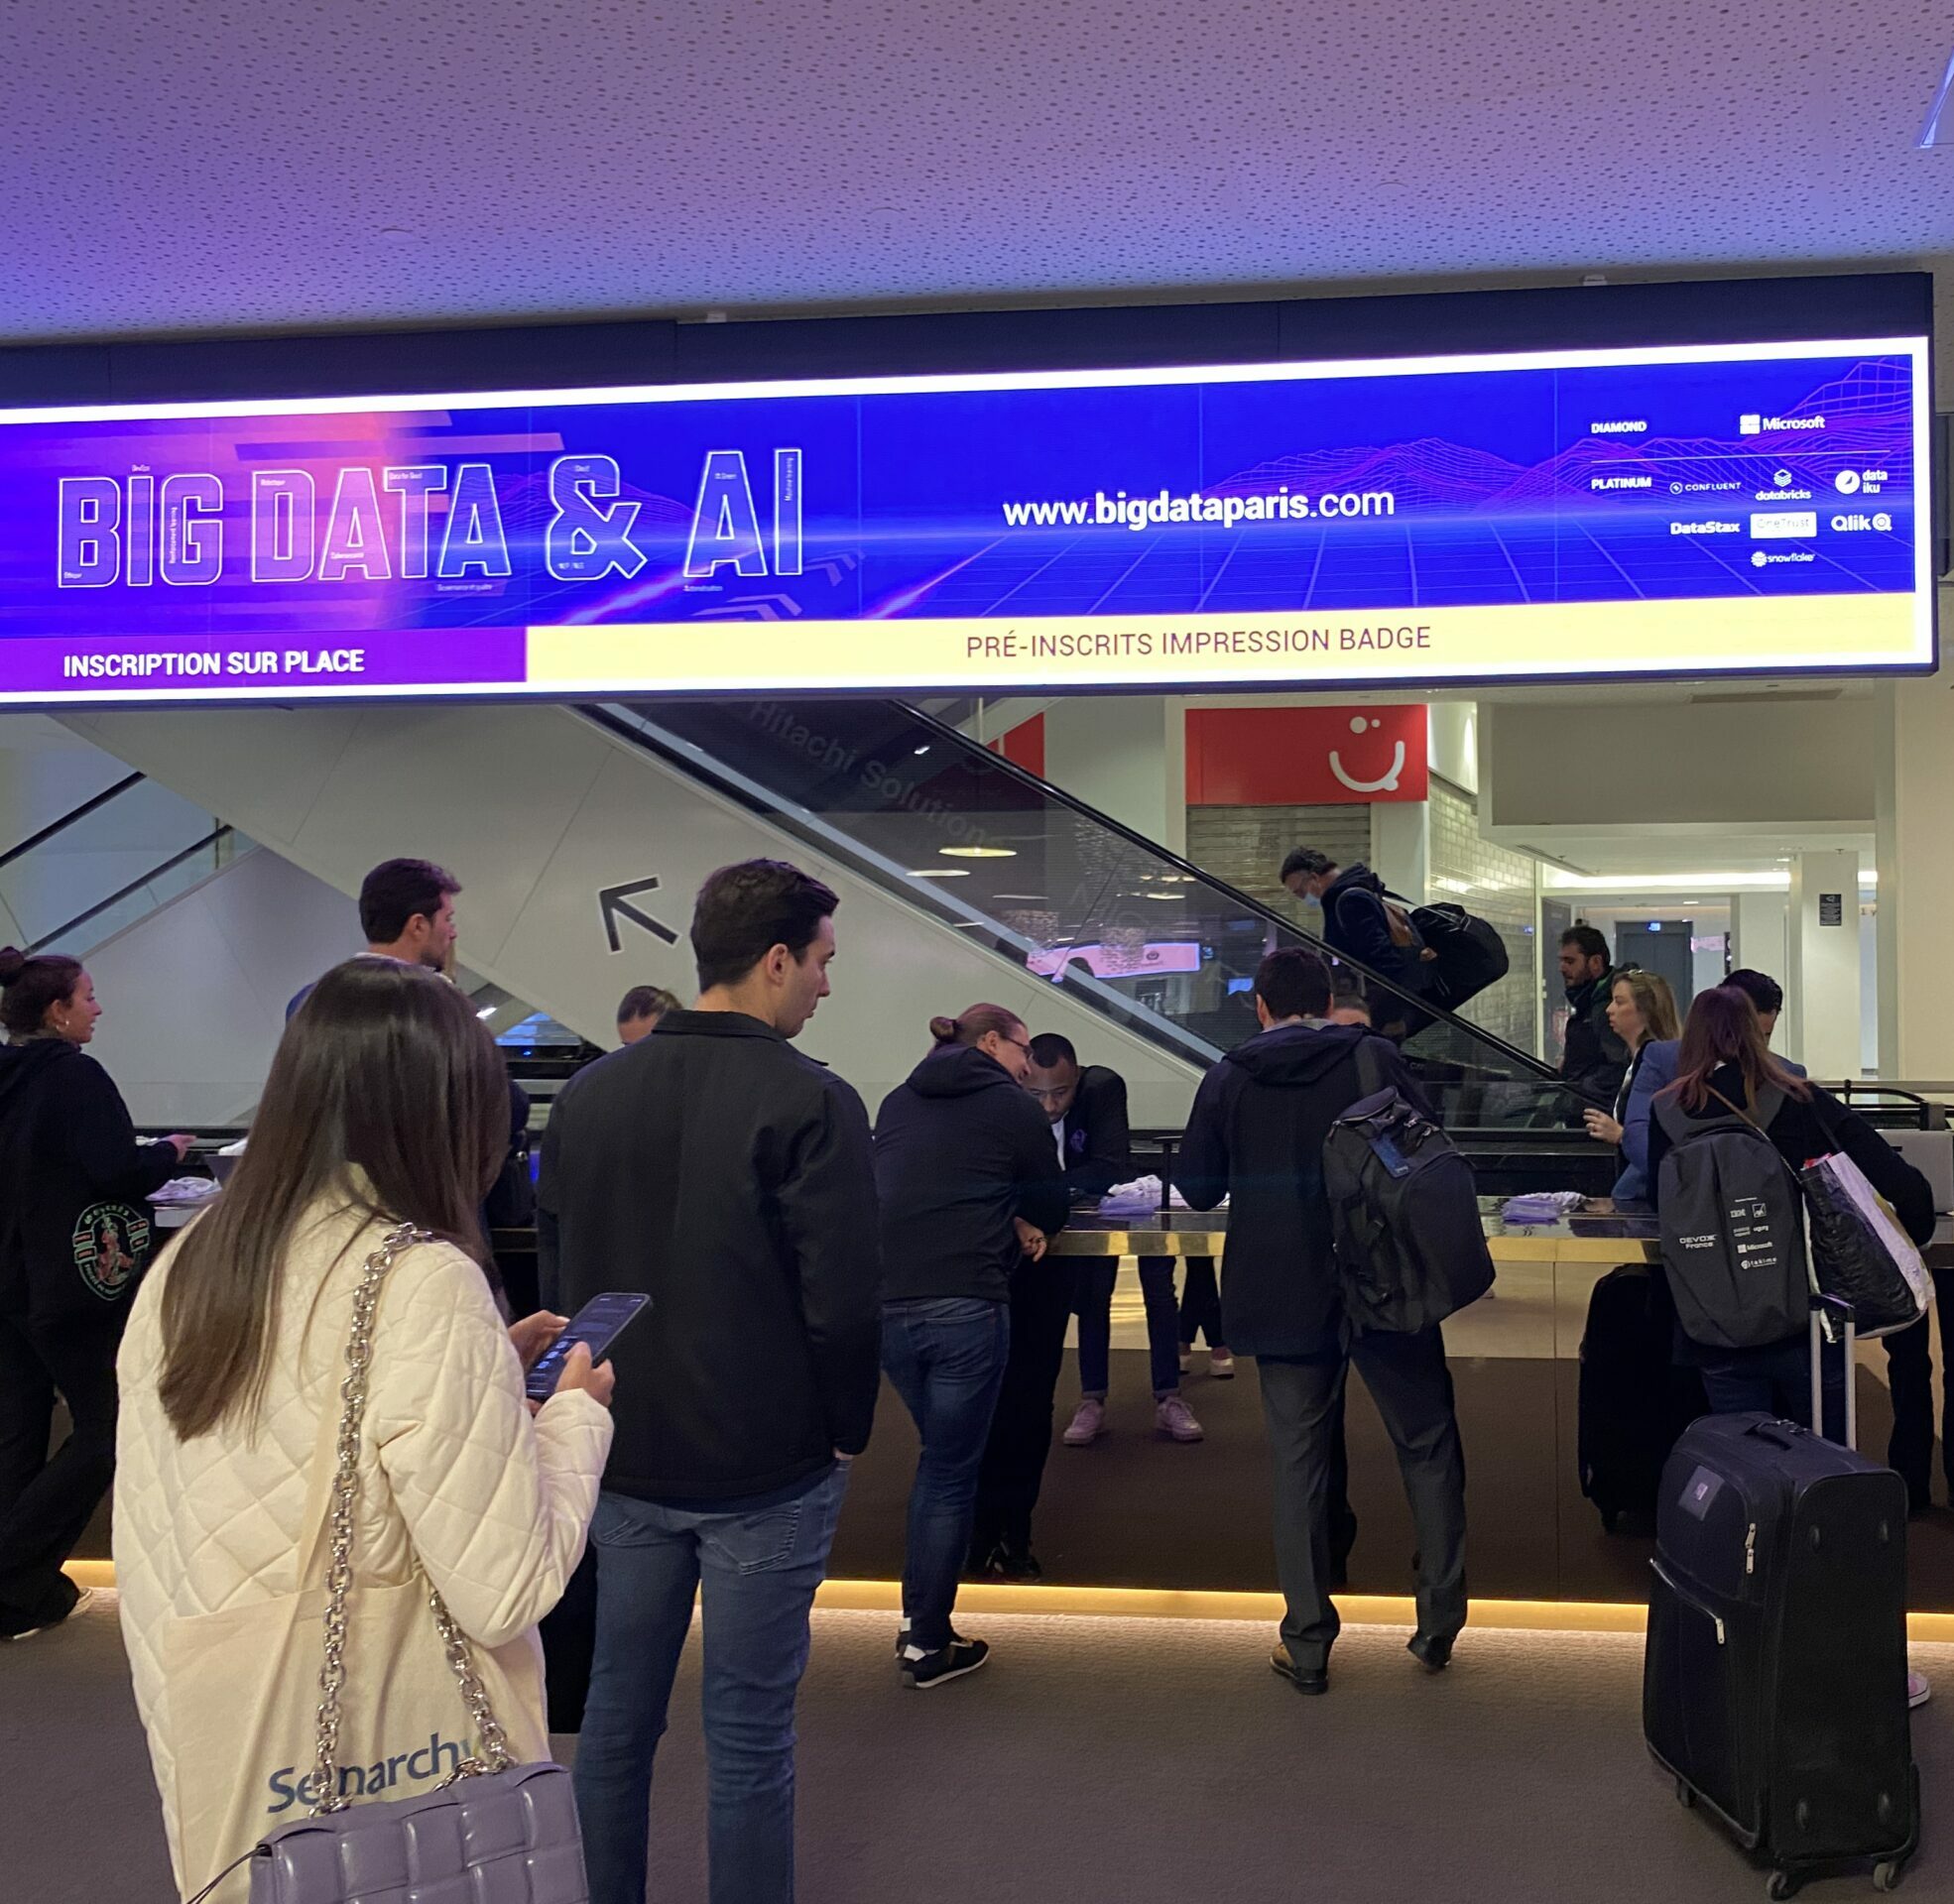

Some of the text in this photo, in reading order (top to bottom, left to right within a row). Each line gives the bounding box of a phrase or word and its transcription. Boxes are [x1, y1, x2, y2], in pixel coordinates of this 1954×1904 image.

[1591, 421, 1648, 434] DIAMOND
[1763, 416, 1825, 430] Microsoft
[1862, 469, 1889, 482] data
[1591, 477, 1651, 490] PLATINUM
[1684, 482, 1742, 491] CONFLUENT
[1862, 482, 1881, 494] iku
[1755, 489, 1812, 501] databricks
[1002, 487, 1395, 532] www.bigdataparis.com
[58, 473, 224, 589] BIG
[252, 464, 512, 582] DATA
[547, 454, 648, 581] &
[683, 448, 802, 577] AI
[1670, 522, 1741, 536] DataStax
[1767, 552, 1814, 563] snowflake
[966, 626, 1432, 658] PRÉ-INSCRITS IMPRESSION BADGE
[63, 649, 365, 678] INSCRIPTION SUR PLACE
